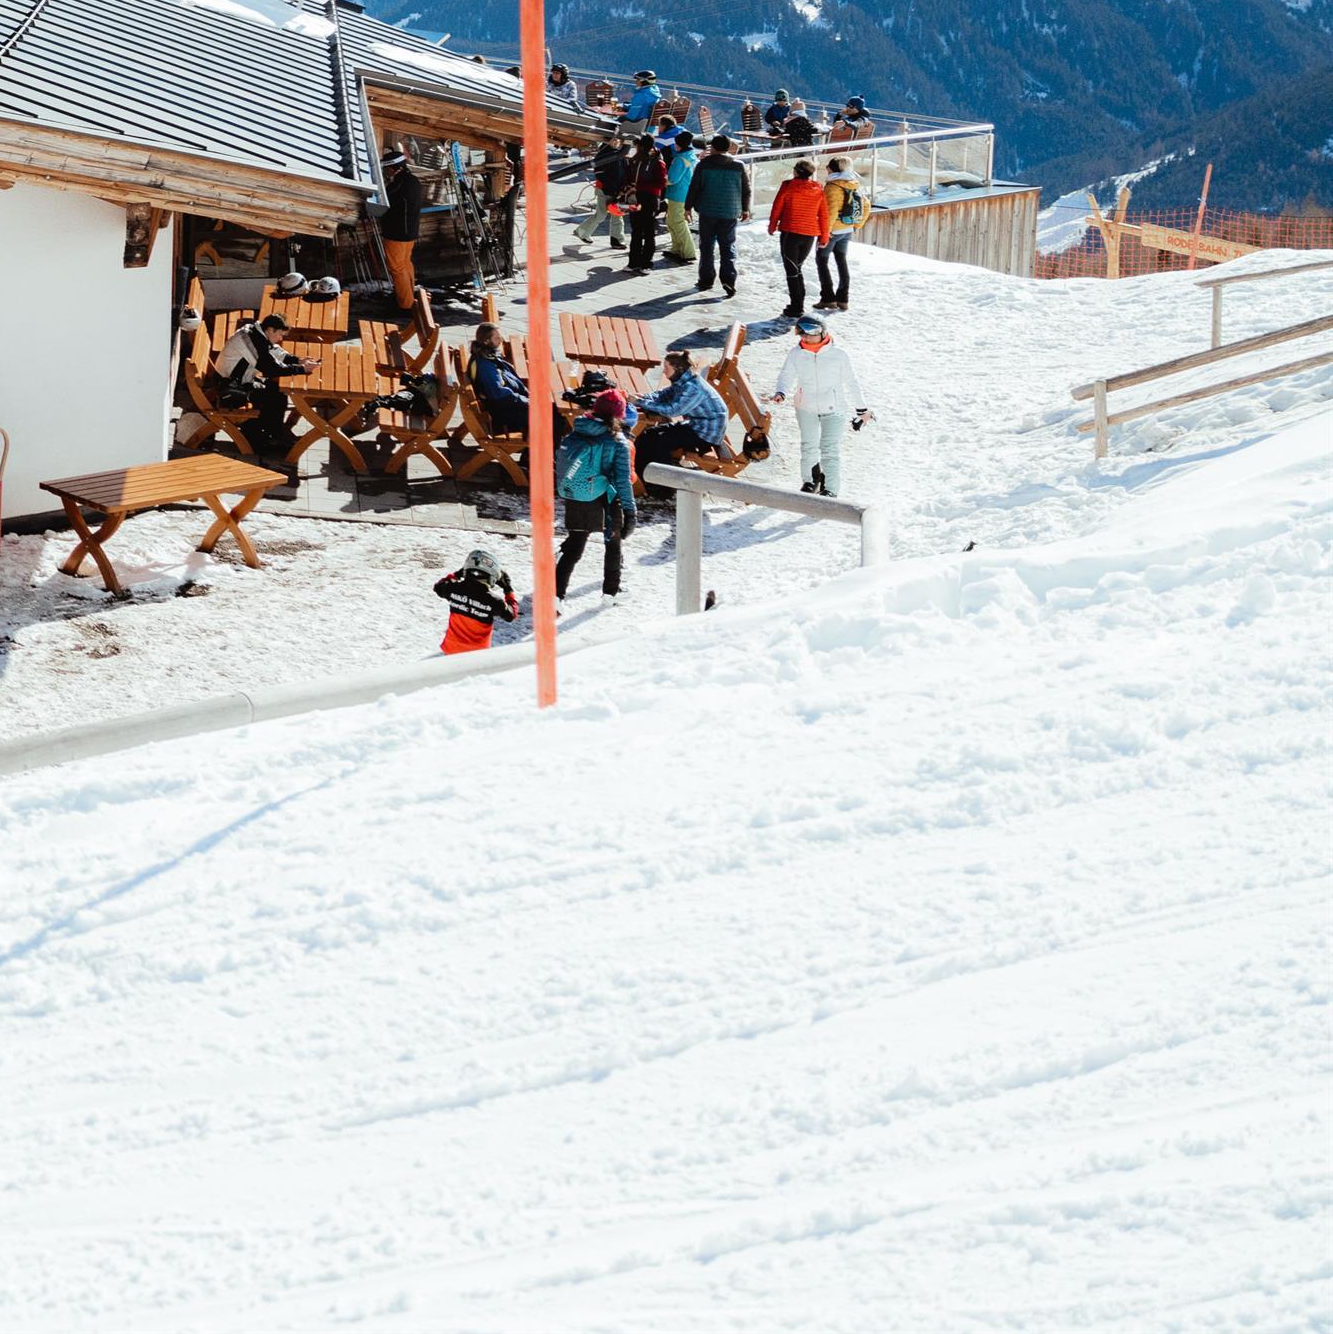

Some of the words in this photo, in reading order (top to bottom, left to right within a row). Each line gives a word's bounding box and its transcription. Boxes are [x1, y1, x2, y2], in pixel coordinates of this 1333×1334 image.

[1167, 235, 1227, 257] RODEBAHN
[566, 458, 582, 480] MILLET
[469, 598, 492, 611] Villach
[470, 607, 489, 617] Team
